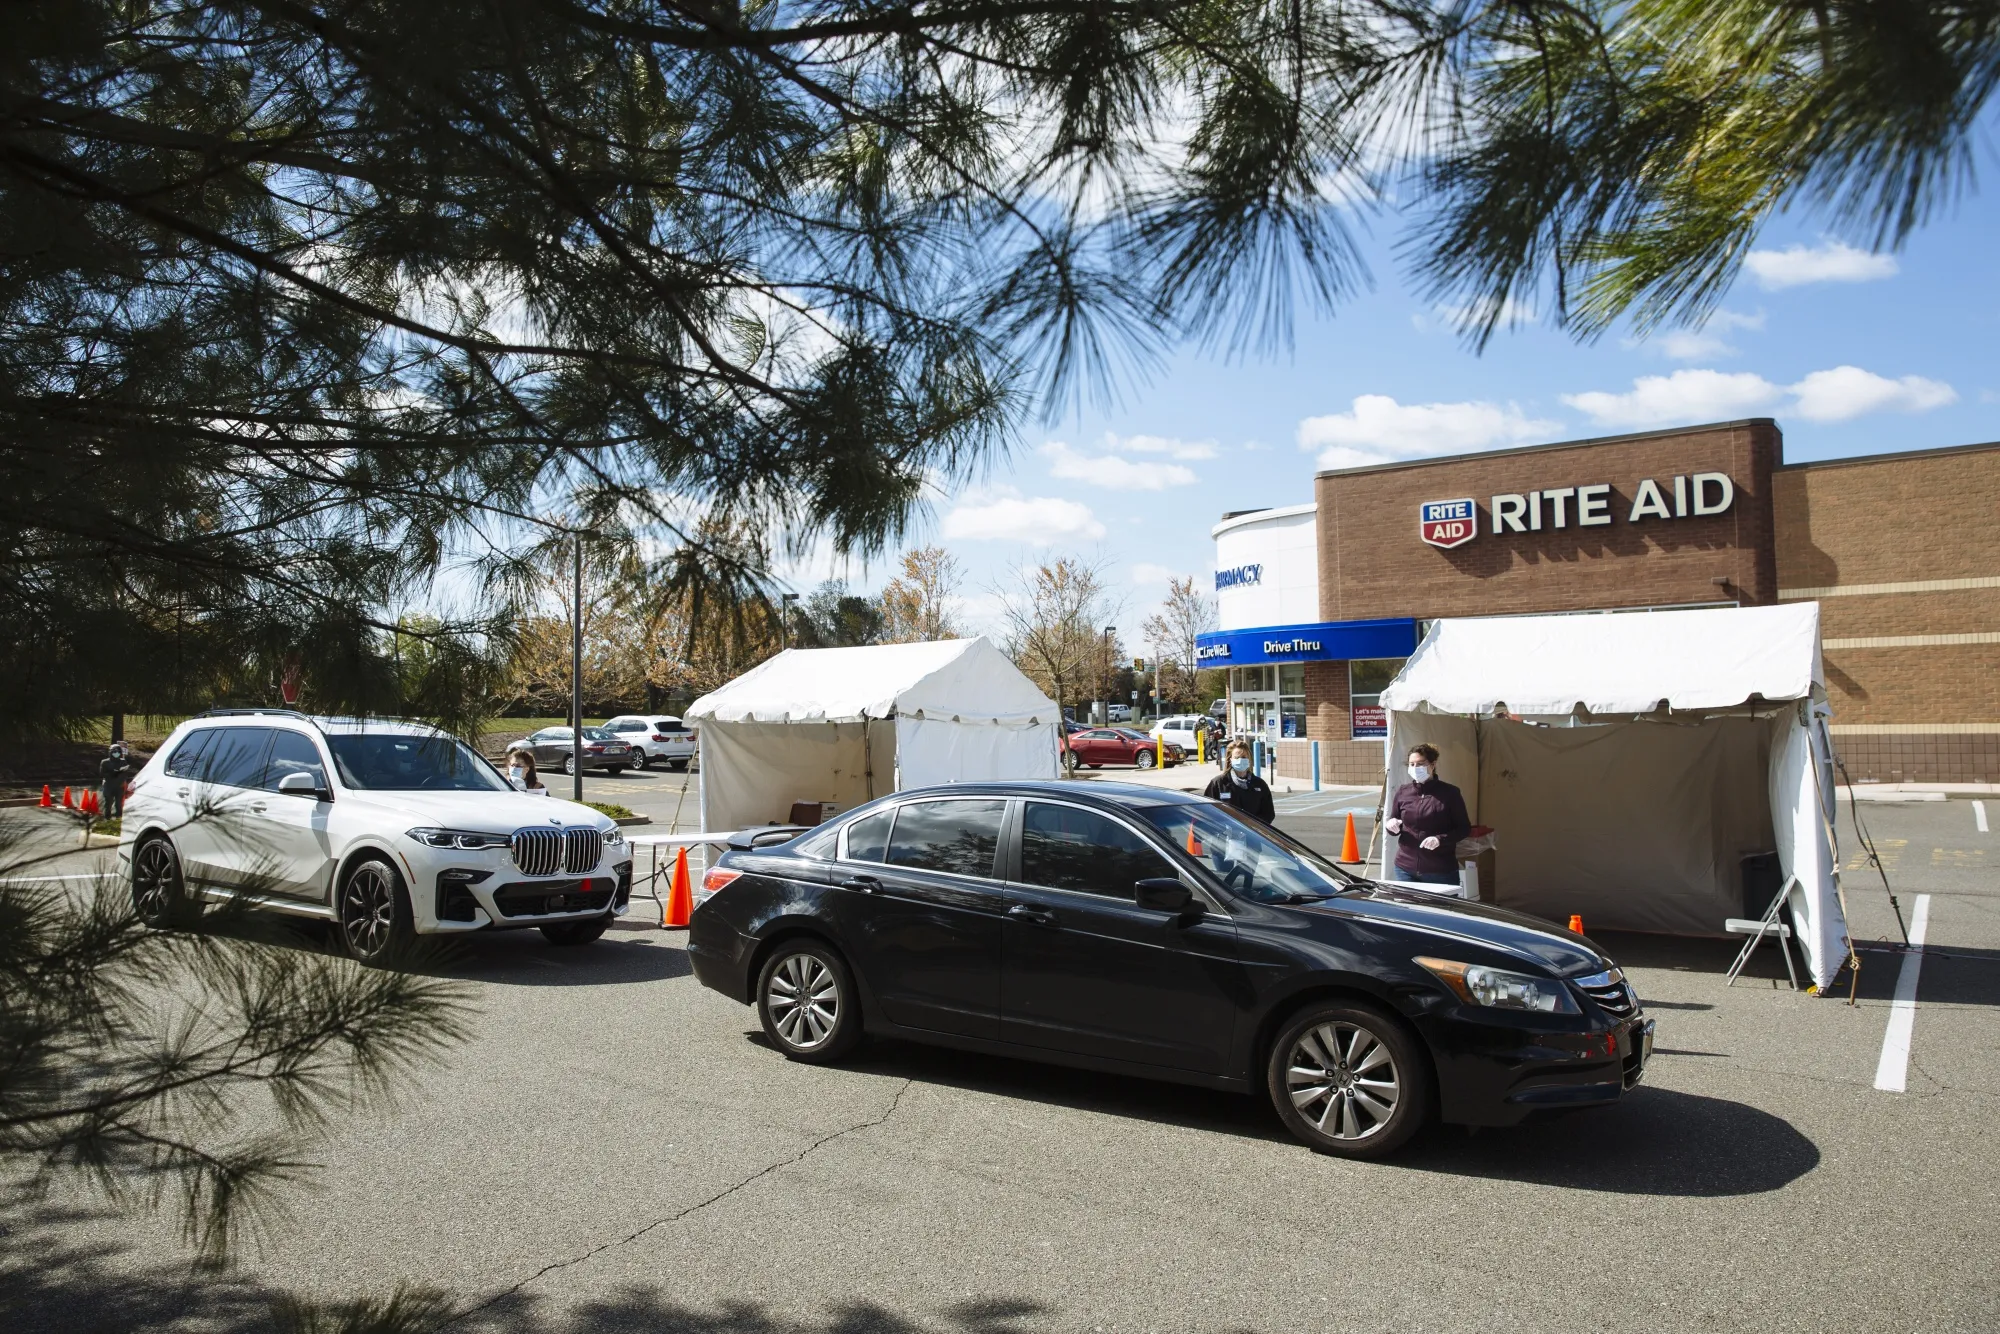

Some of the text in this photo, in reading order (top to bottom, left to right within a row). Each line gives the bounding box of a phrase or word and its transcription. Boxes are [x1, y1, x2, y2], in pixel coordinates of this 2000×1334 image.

[1429, 503, 1466, 520] RITE
[1492, 472, 1735, 534] RITE AID
[1432, 523, 1464, 540] AID
[1214, 563, 1261, 592] RMACY
[1264, 640, 1291, 653] Drive
[1292, 639, 1320, 651] Thru
